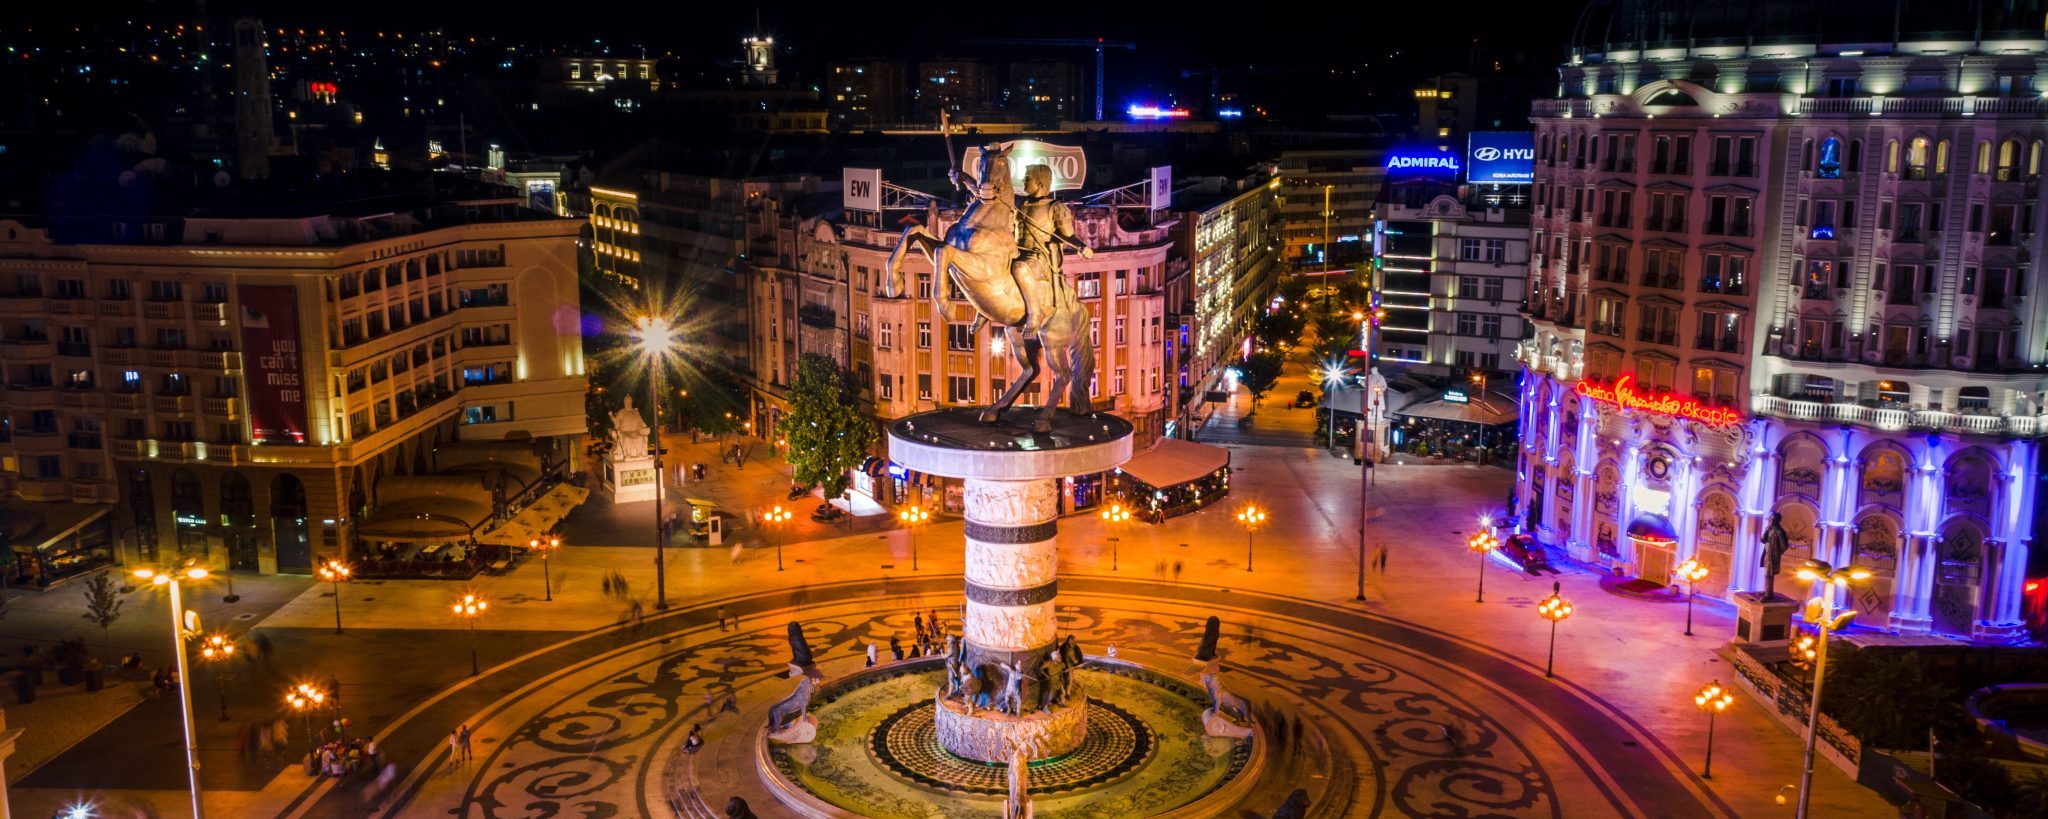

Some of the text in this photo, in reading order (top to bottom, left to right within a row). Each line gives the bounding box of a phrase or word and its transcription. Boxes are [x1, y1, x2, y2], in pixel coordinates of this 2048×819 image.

[1388, 156, 1459, 169] ADMIRAL
[850, 180, 870, 198] EVN
[272, 340, 296, 357] you
[267, 369, 300, 386] miss
[281, 389, 301, 402] me
[1576, 381, 1615, 401] Casino
[1680, 401, 1739, 428] Skopje
